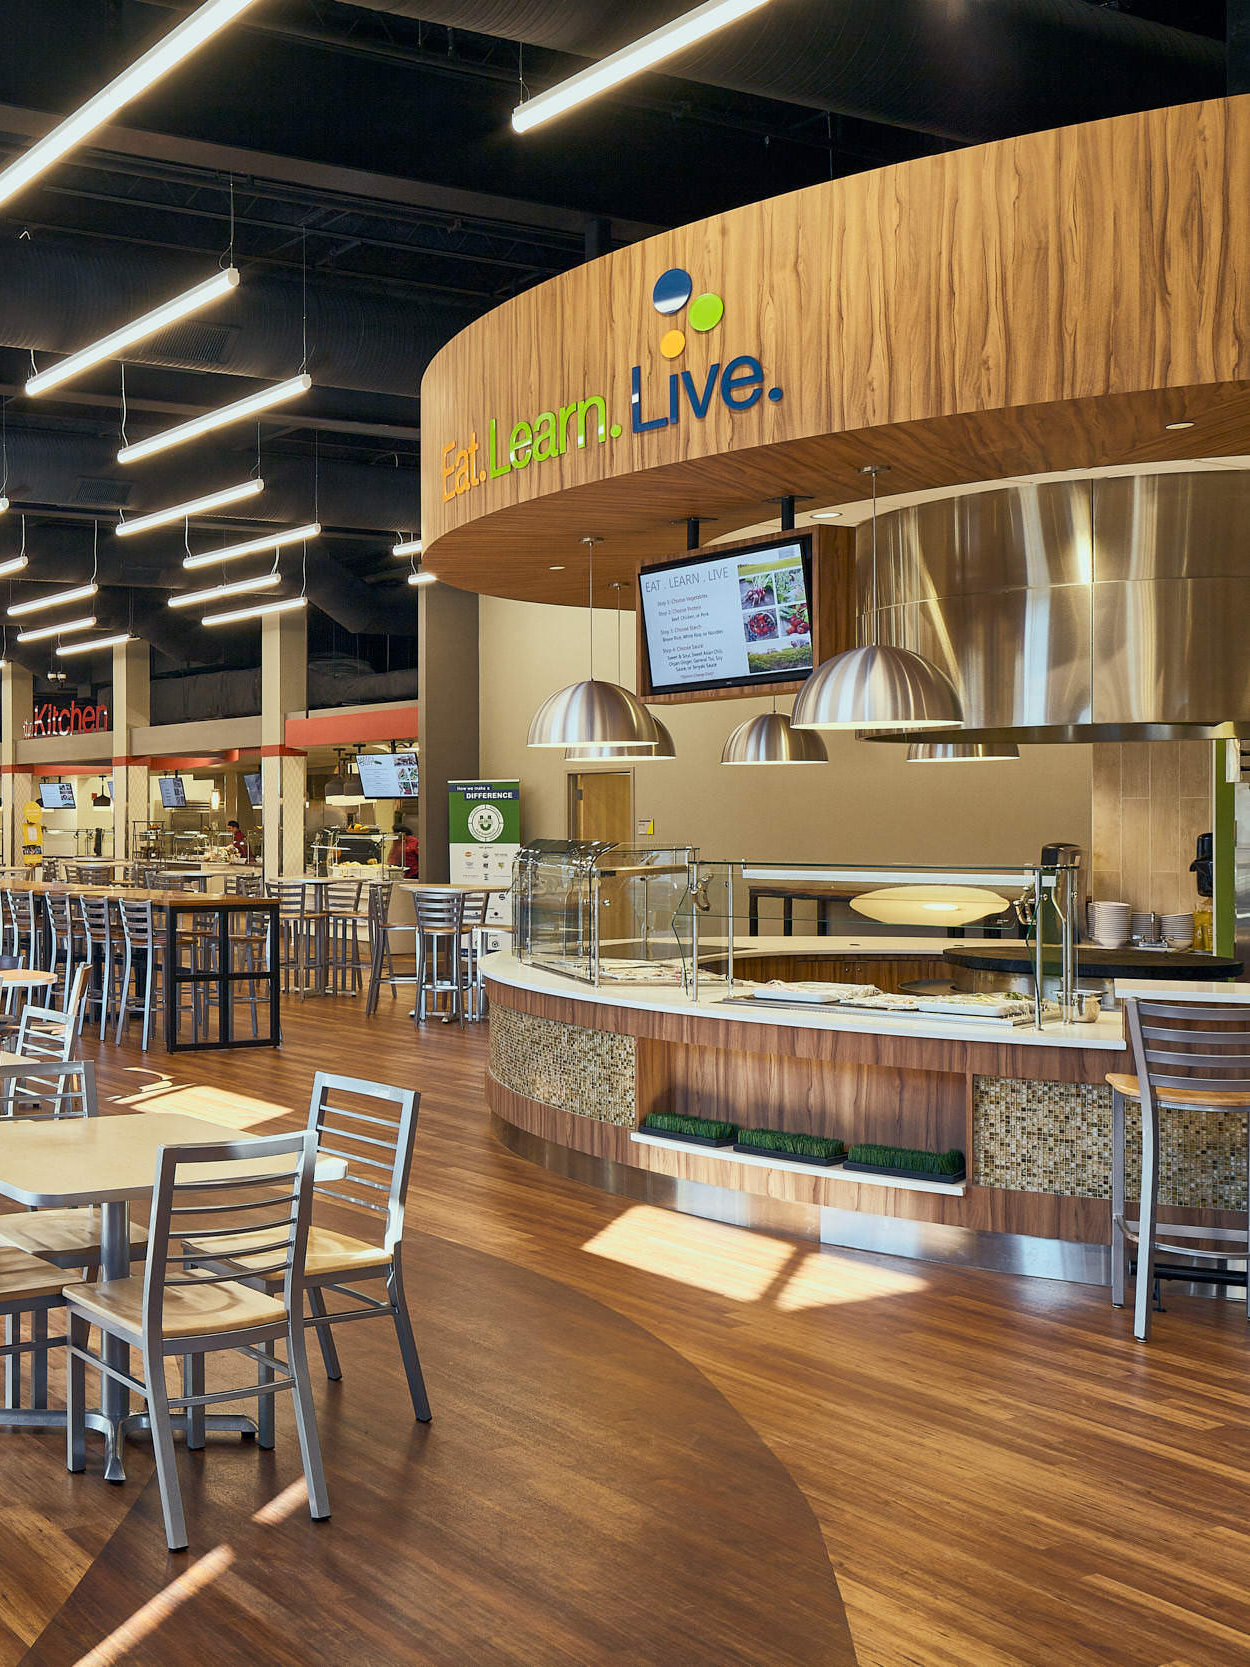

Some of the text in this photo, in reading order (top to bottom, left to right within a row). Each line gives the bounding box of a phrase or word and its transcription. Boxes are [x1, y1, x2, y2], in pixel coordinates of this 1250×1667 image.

[442, 355, 784, 503] Eat. Learn. Live.
[645, 567, 729, 593] EAT LEARN LIVE
[34, 700, 109, 737] Kitchen
